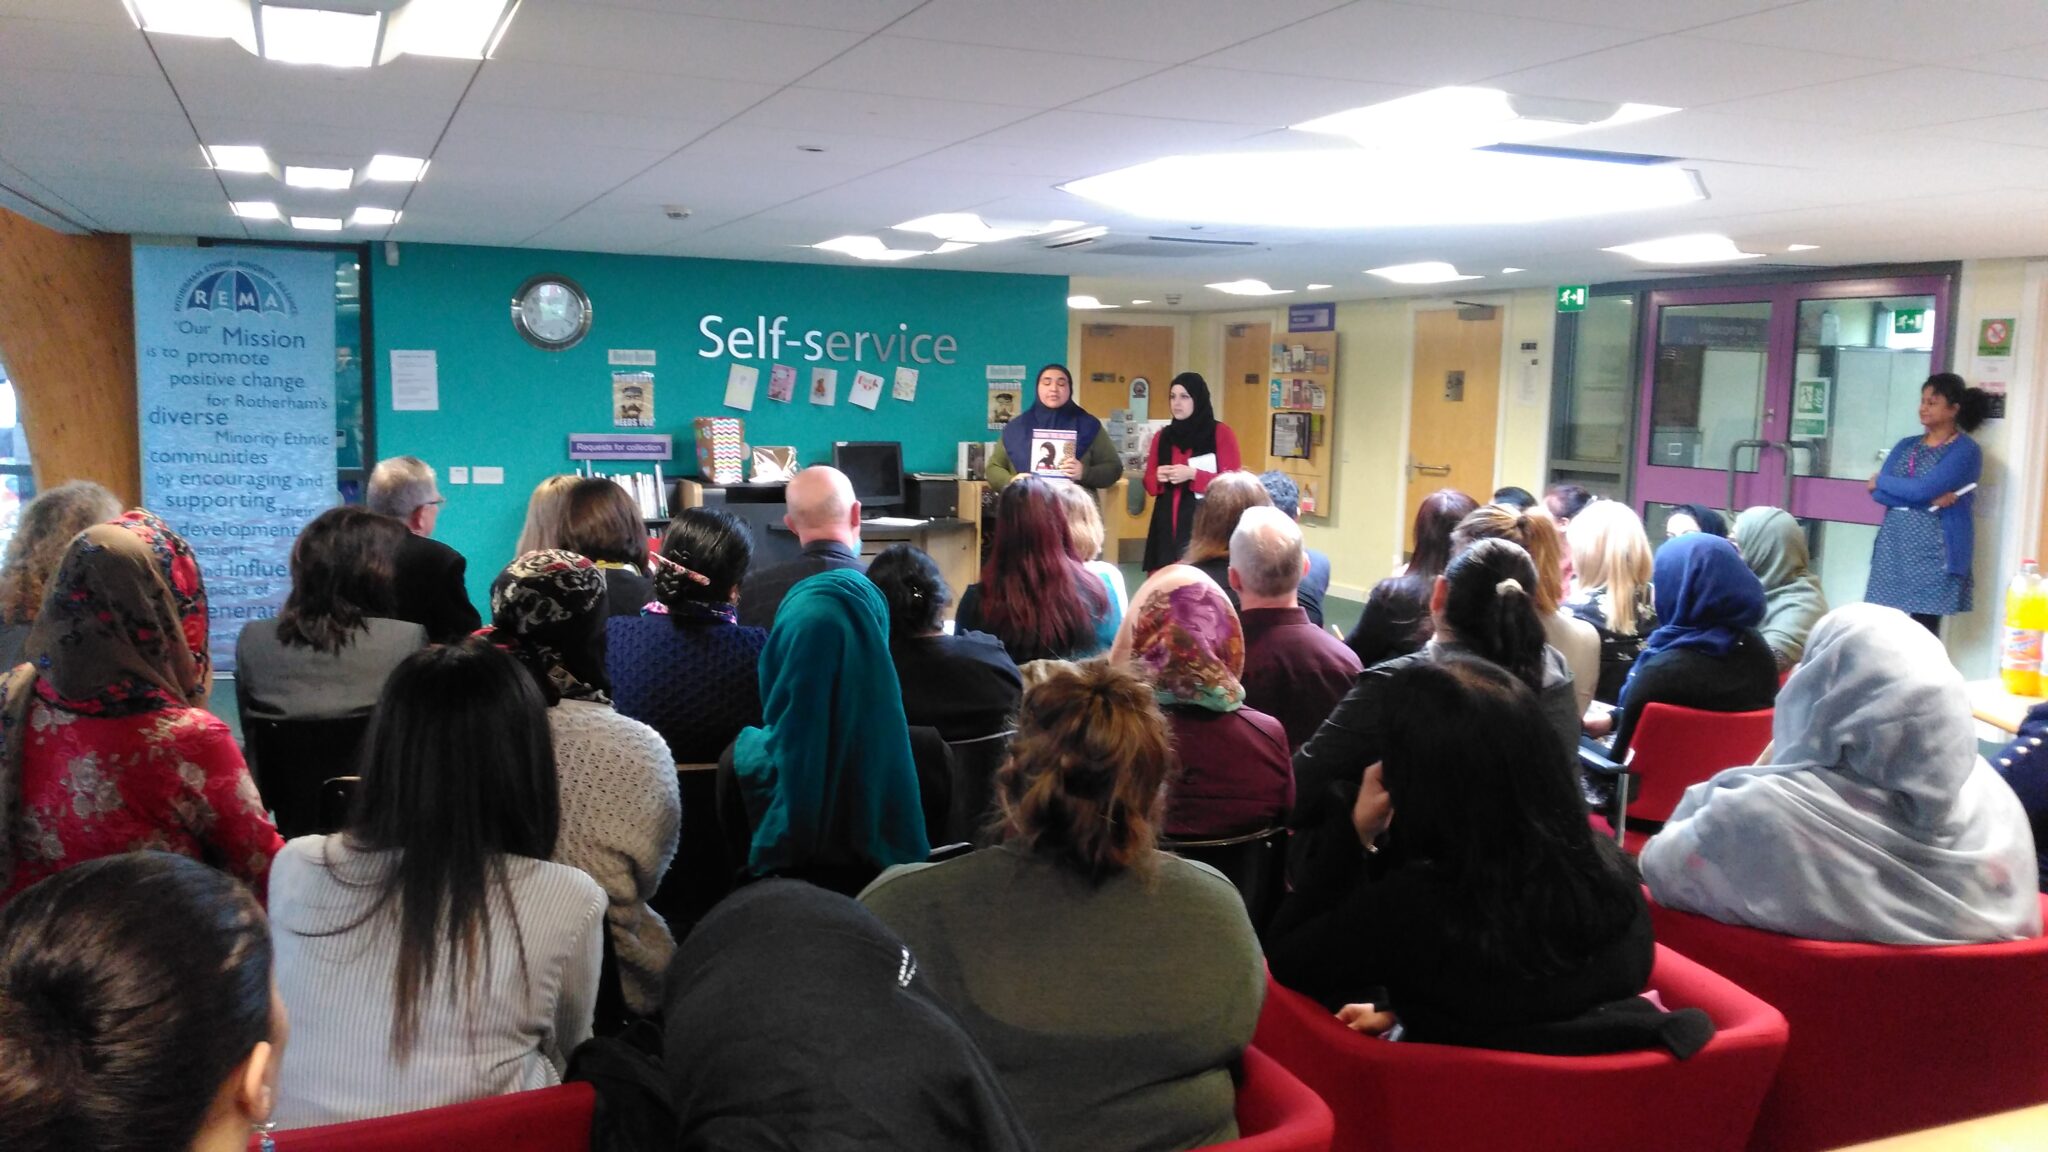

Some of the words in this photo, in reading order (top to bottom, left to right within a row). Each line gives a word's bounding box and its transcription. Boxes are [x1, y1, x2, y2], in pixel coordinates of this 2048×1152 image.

[195, 289, 278, 307] REMA
[222, 326, 305, 349] Mission
[699, 314, 958, 365] Self-service
[146, 348, 157, 358] is
[162, 348, 180, 359] to
[187, 351, 270, 368] promote
[169, 373, 236, 389] positive
[242, 372, 305, 393] change
[206, 395, 228, 407] for
[235, 395, 328, 410] Rotherham's
[149, 405, 229, 426] diverse
[215, 431, 279, 447] Minority
[284, 432, 329, 446] Ethnic
[576, 443, 613, 453] Requests
[614, 443, 625, 451] for
[626, 443, 662, 452] collection
[150, 450, 268, 465] communities
[156, 474, 174, 488] by
[180, 472, 292, 490] encouraging
[296, 475, 324, 487] and
[166, 493, 276, 512] supporting
[280, 506, 316, 518] their
[178, 522, 299, 541] development
[198, 545, 244, 556] ement
[204, 566, 223, 577] nd
[227, 559, 288, 577] influe
[207, 584, 248, 597] pects
[255, 584, 271, 596] of
[206, 605, 276, 620] enerat
